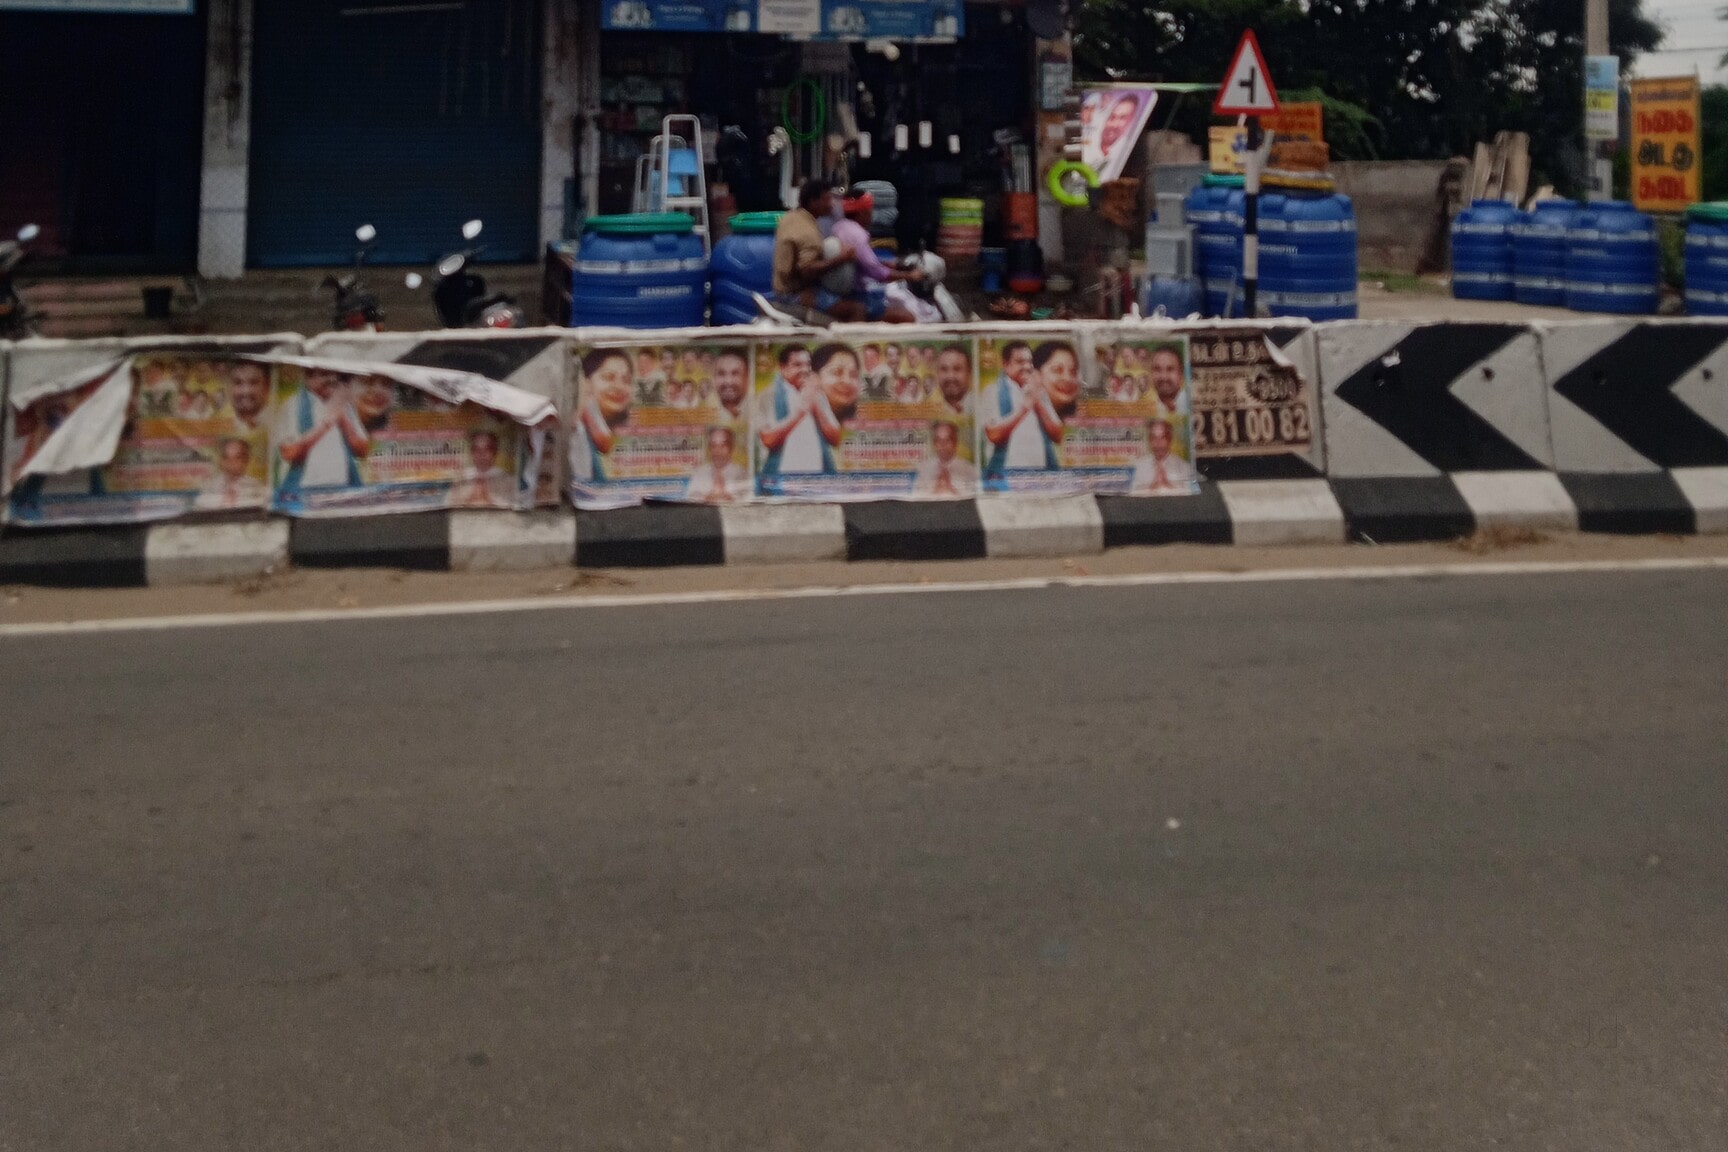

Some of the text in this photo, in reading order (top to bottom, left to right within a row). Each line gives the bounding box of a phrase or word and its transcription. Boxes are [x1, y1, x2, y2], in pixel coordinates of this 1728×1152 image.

[1636, 109, 1695, 135] நகை
[1638, 139, 1695, 172] அடகு
[1639, 175, 1692, 201] கடை
[1212, 409, 1239, 442] 81
[1246, 409, 1275, 441] 00
[1280, 409, 1310, 440] 82
